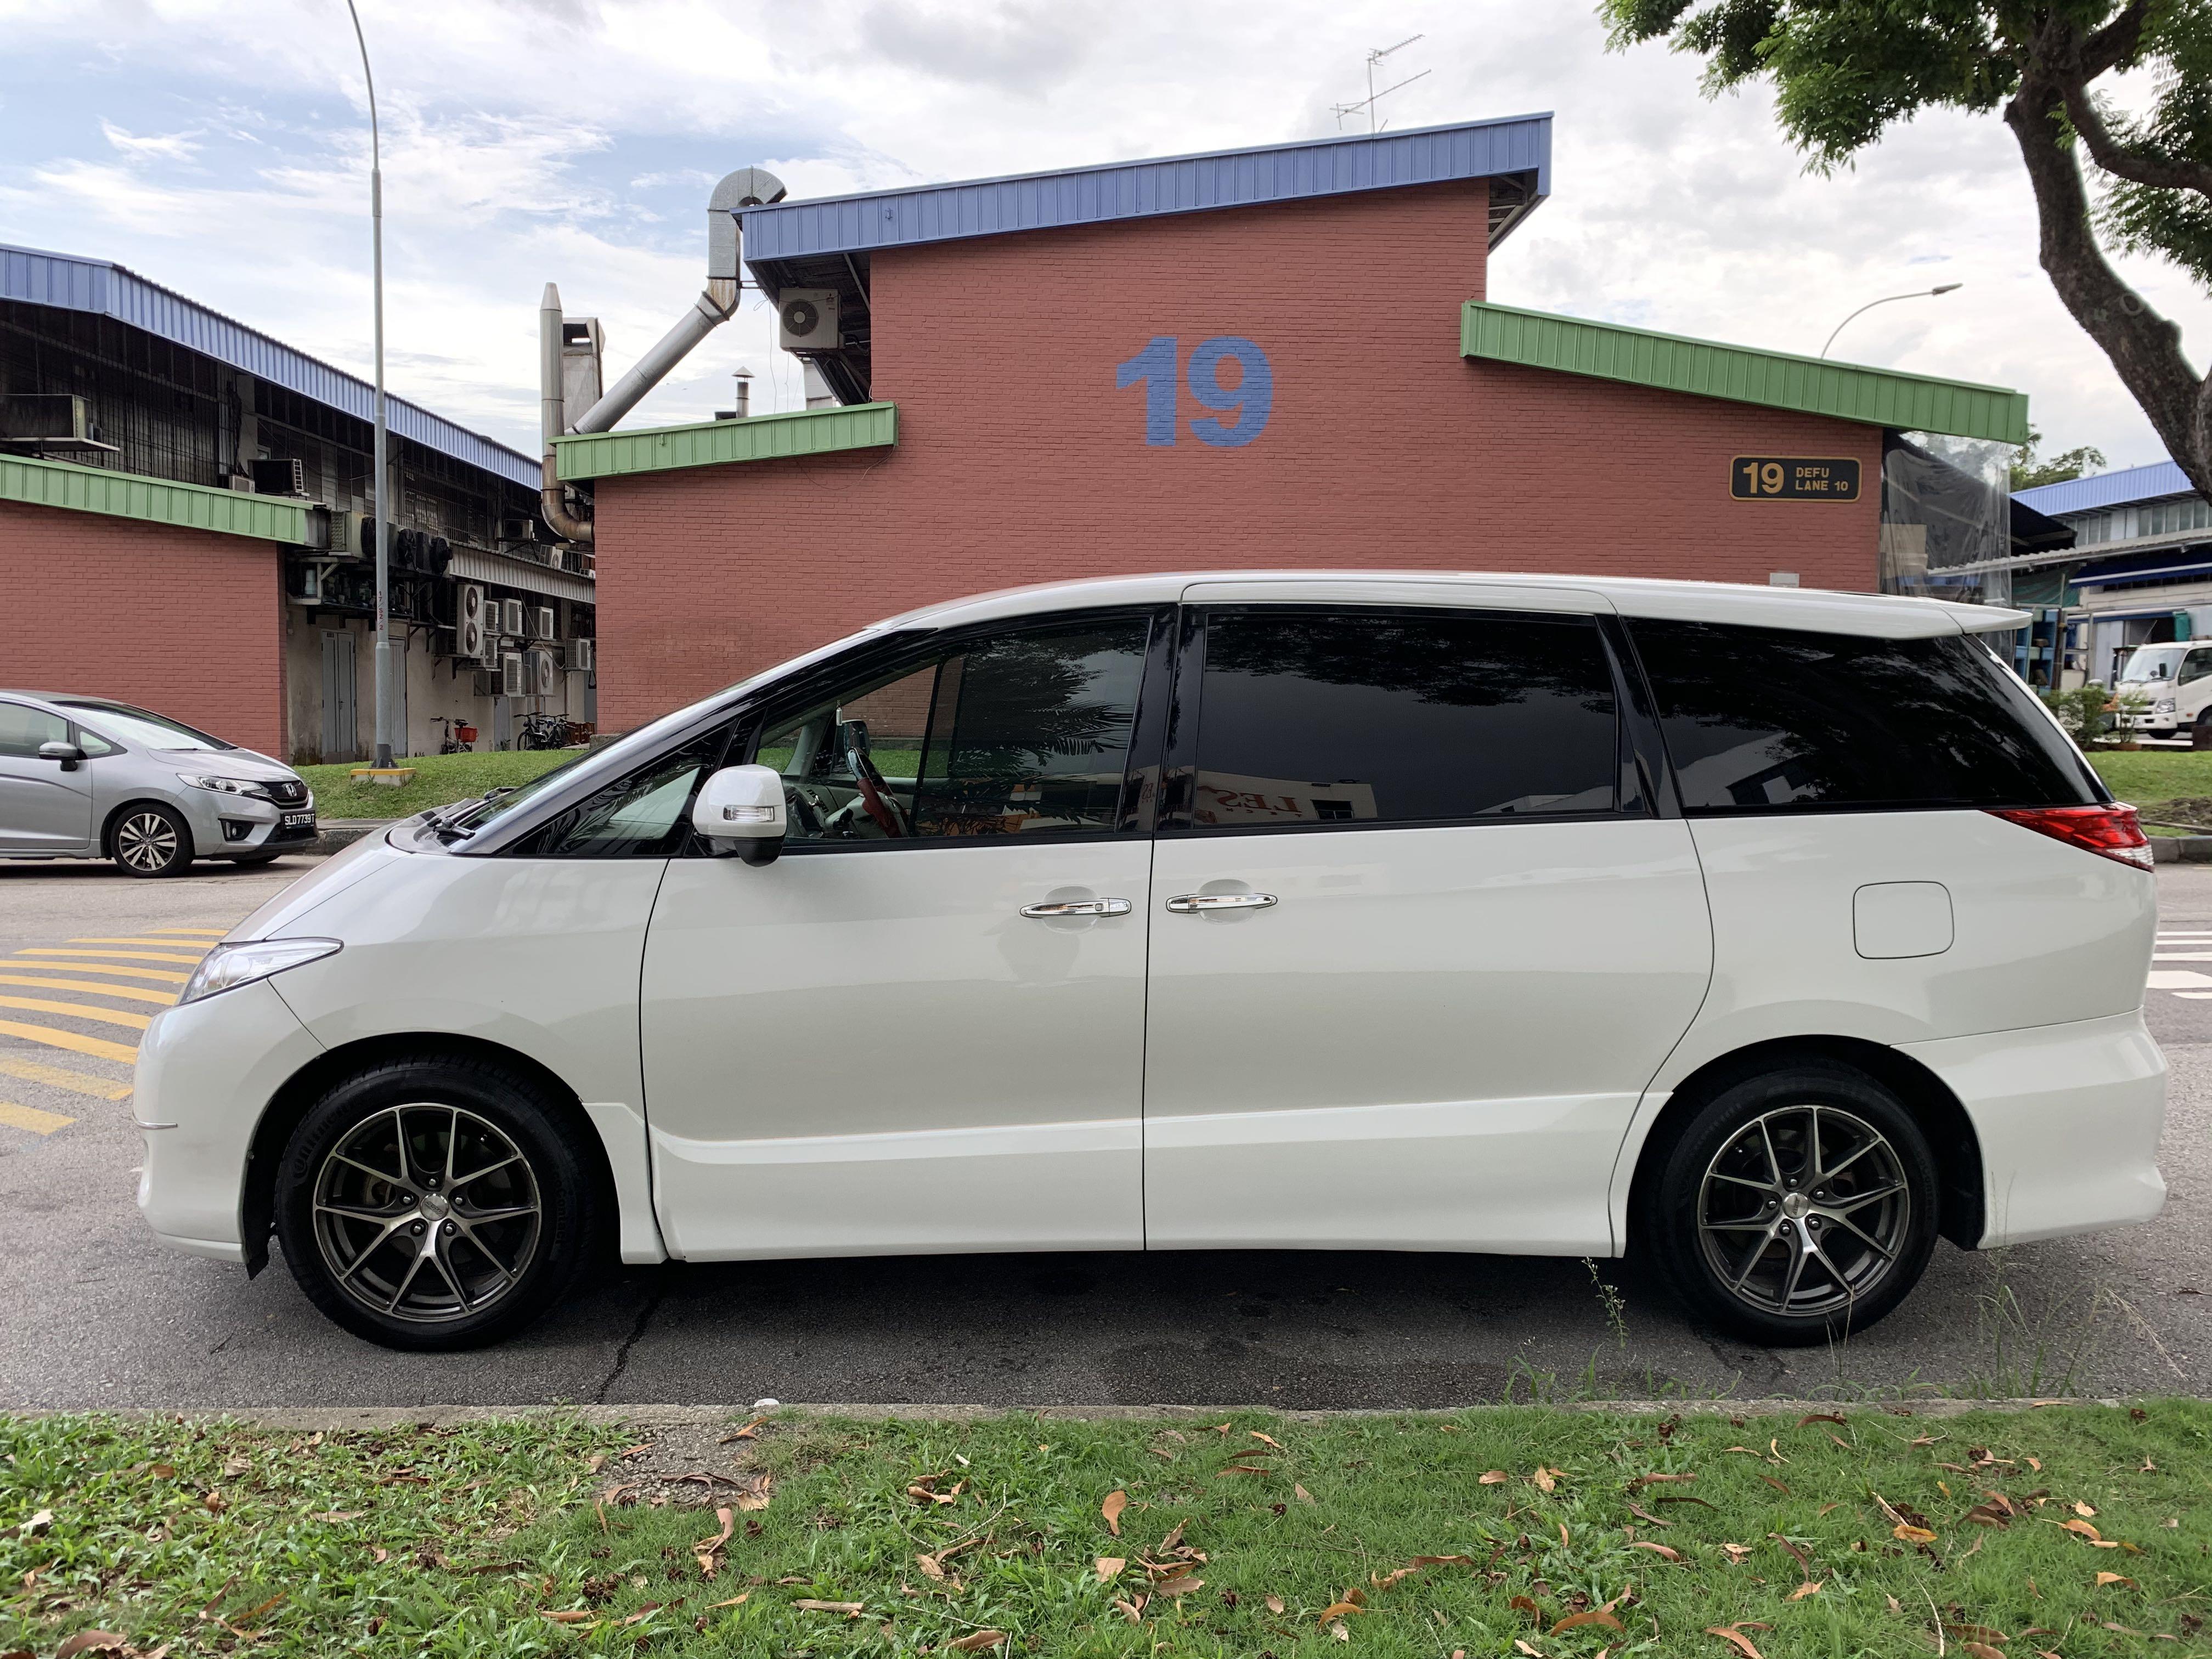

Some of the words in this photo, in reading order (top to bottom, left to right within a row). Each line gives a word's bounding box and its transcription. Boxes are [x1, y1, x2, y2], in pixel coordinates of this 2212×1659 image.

[1116, 336, 1273, 447] 19
[1742, 462, 1785, 494] 19
[1795, 467, 1830, 478] DEFU
[1795, 479, 1829, 491] LANE
[1834, 481, 1849, 492] 10
[285, 813, 315, 826] SLD7739T
